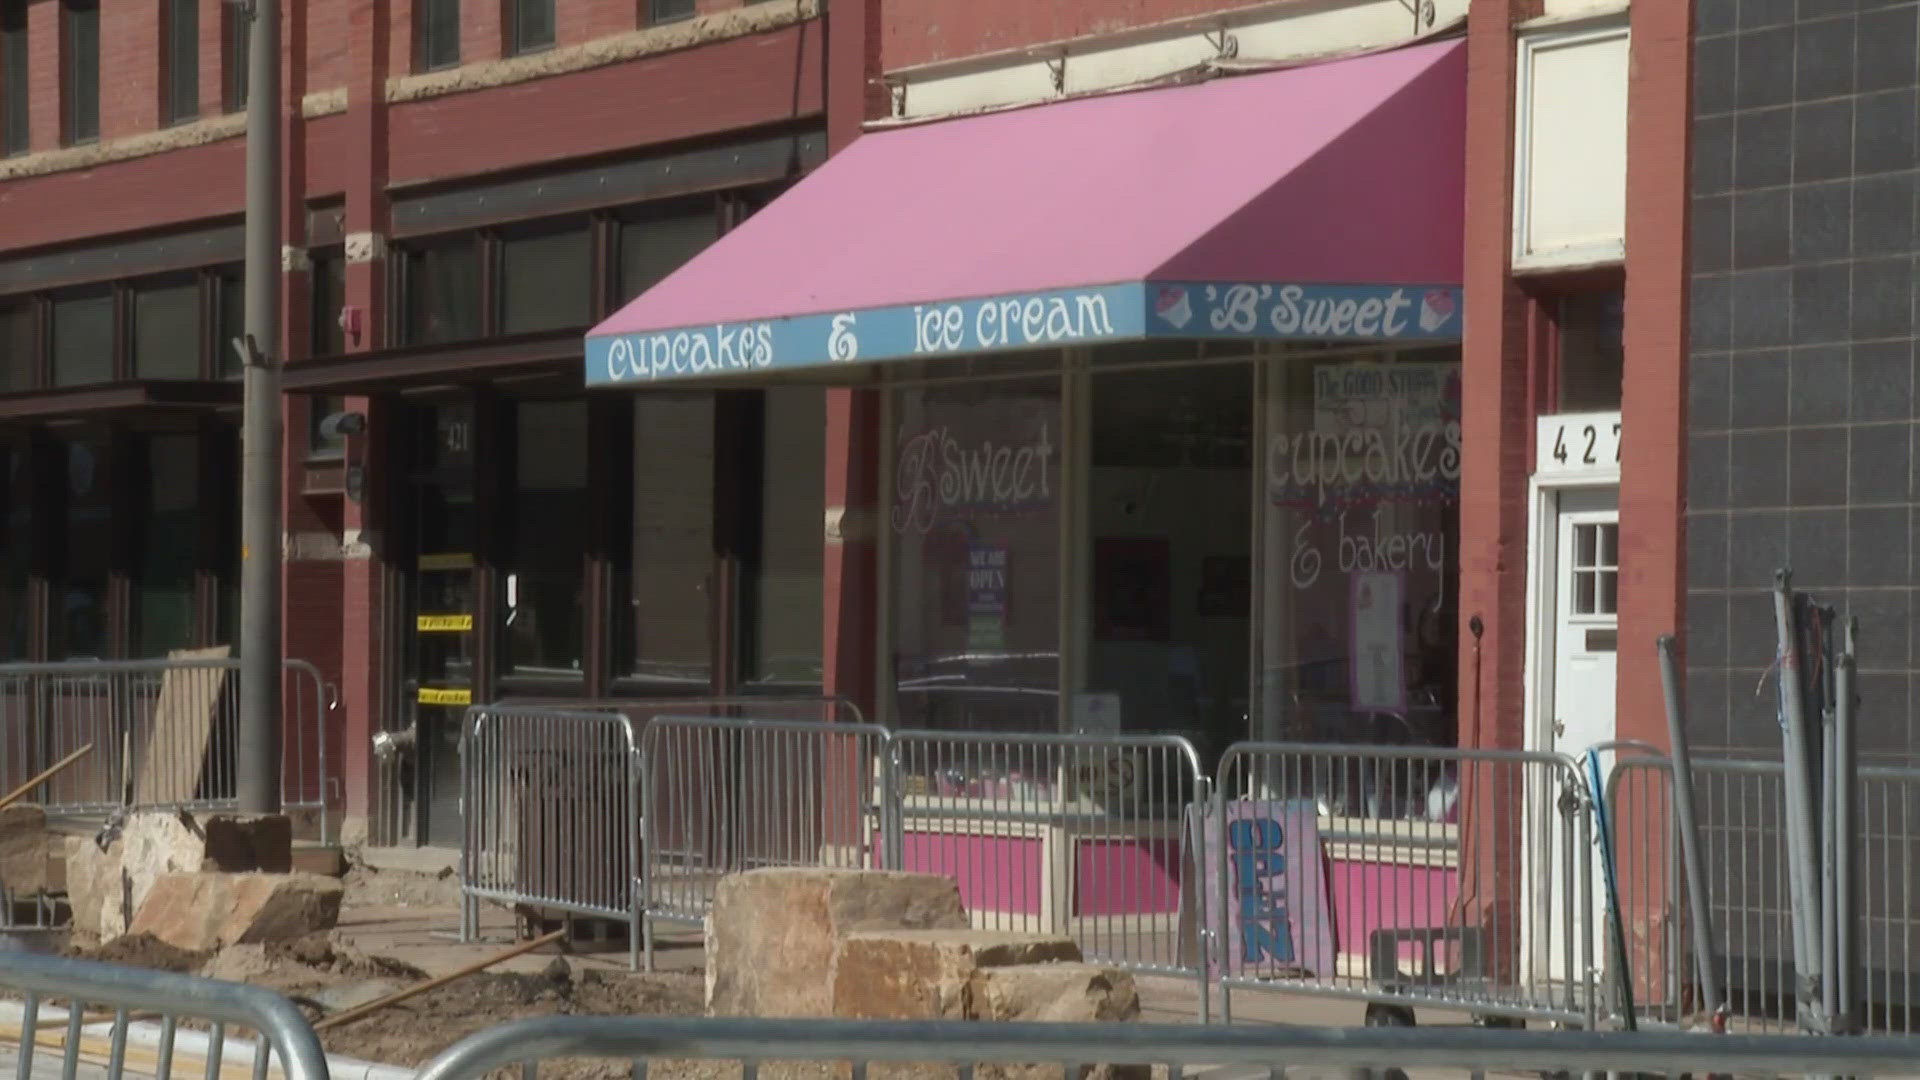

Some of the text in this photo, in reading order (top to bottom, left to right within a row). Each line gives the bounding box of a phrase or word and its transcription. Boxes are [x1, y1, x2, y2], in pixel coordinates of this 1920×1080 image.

[607, 323, 773, 381] cupcakes
[914, 305, 964, 353] ice
[975, 293, 1114, 347] cream
[1339, 509, 1445, 613] bakery
[1229, 818, 1296, 962] OPEN
